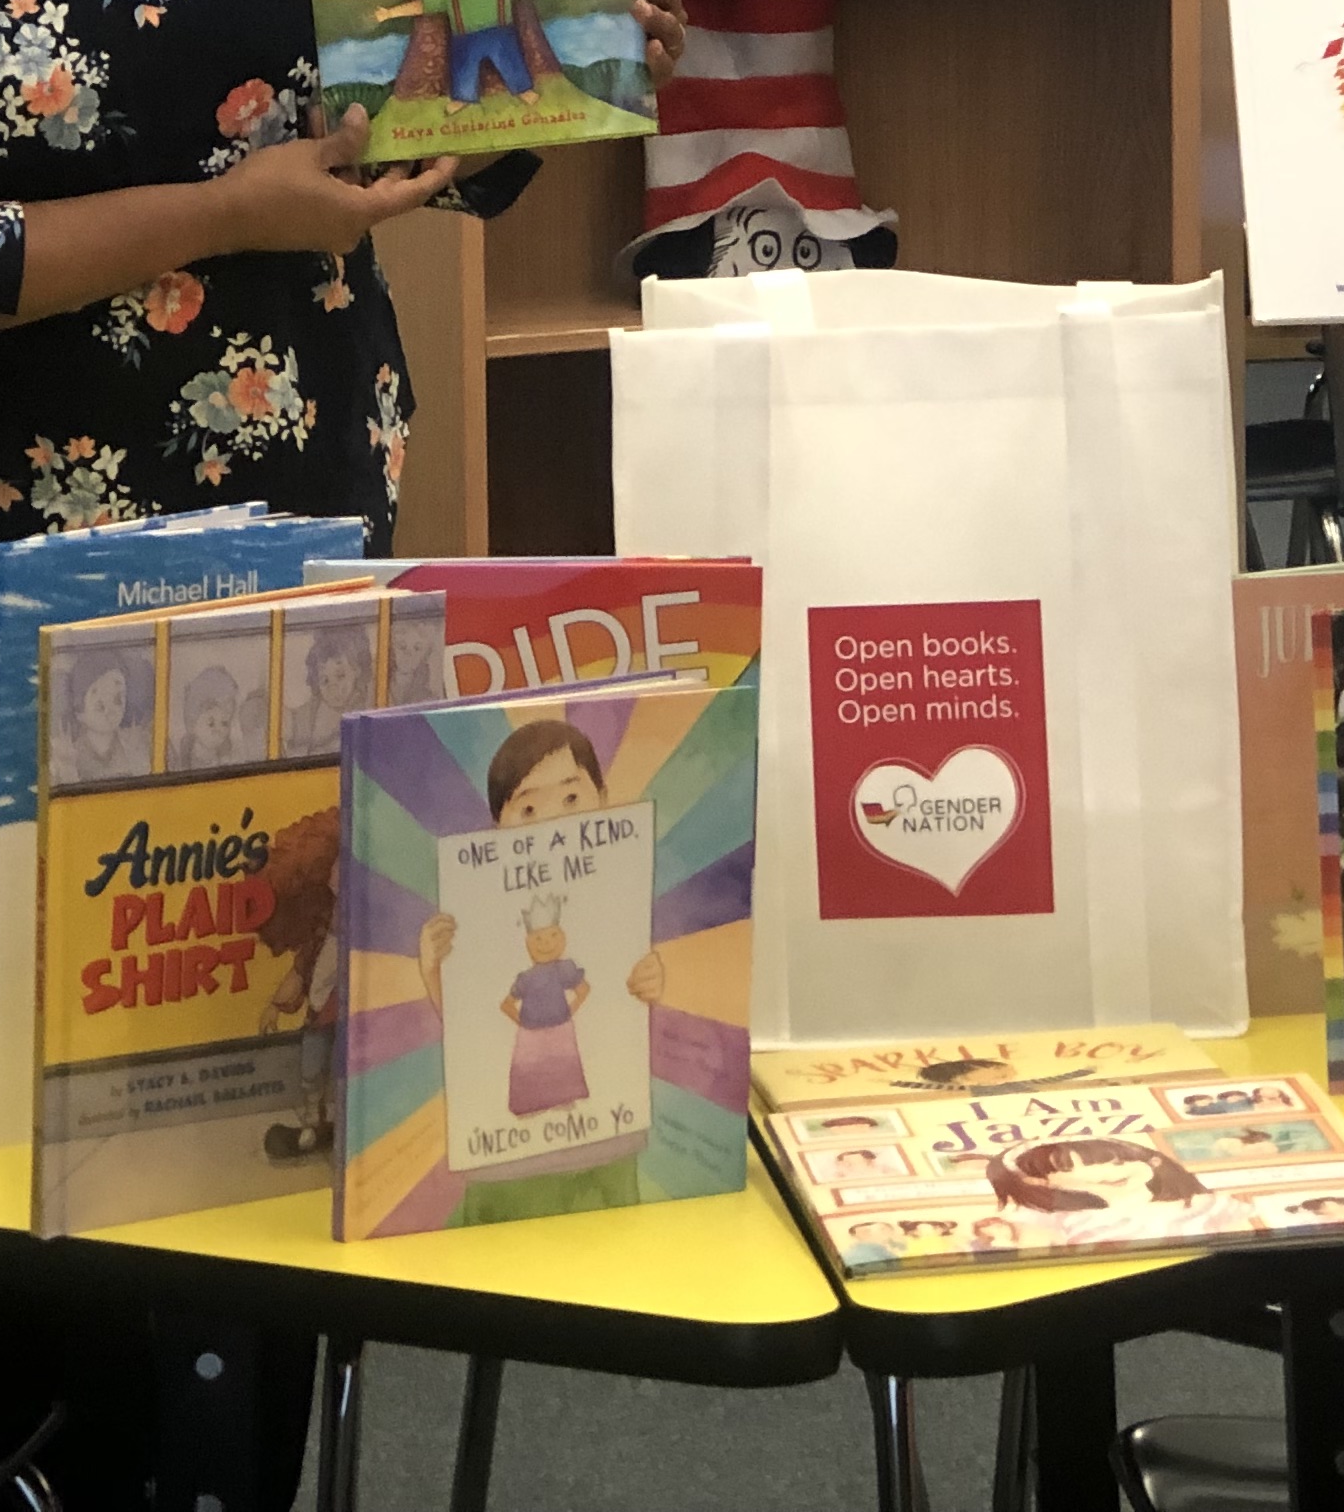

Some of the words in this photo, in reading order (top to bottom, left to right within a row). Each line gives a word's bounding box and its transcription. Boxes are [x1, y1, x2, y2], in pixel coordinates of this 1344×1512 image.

[118, 578, 208, 607] Michael
[216, 570, 259, 598] Hall
[834, 636, 913, 663] Open
[923, 631, 1018, 657] books.
[835, 668, 913, 695] Open
[923, 663, 1020, 688] hearts.
[838, 700, 916, 727] Open
[926, 695, 1020, 721] minds.
[902, 816, 985, 833] NATION
[919, 797, 1002, 817] GENDER
[84, 807, 270, 897] Annie's
[458, 841, 499, 868] ONE
[513, 837, 535, 855] OF
[549, 830, 565, 851] A
[504, 861, 552, 892] LIKE
[563, 855, 596, 882] ME
[110, 878, 276, 951] PLAID
[80, 937, 256, 1015] SHIRT
[1054, 1040, 1165, 1062] BOY
[1026, 1088, 1125, 1116] Am
[543, 1113, 599, 1142] COMO
[611, 1103, 634, 1134] YO
[932, 1114, 1158, 1152] Jazz
